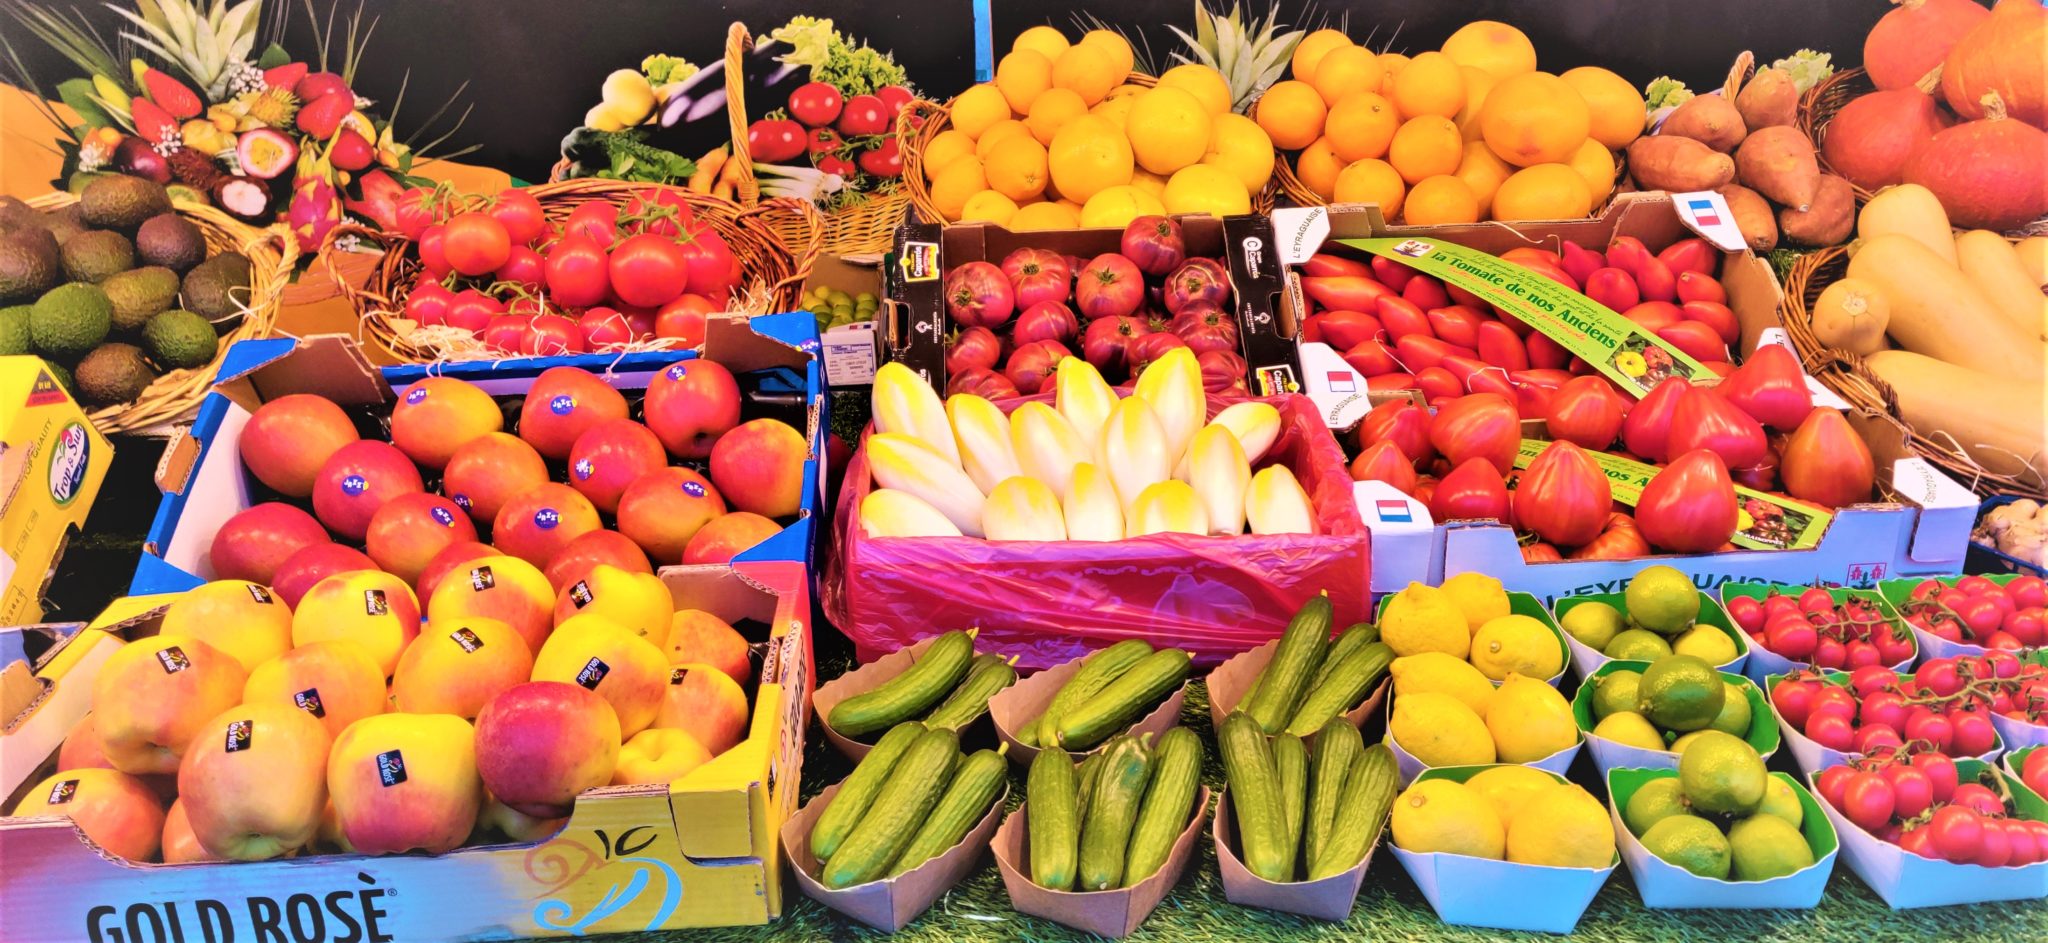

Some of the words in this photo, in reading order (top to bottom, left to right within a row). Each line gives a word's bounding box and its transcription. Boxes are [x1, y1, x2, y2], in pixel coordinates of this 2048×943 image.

[1293, 207, 1323, 258] L'EYRAGUAISE
[1431, 252, 1447, 262] la
[1449, 257, 1504, 285] Tomate
[1505, 283, 1526, 296] de
[1526, 293, 1556, 312] nos
[1556, 309, 1617, 349] Anciens
[54, 467, 72, 500] Trop
[67, 424, 84, 456] Sun
[86, 899, 235, 943] GOLD
